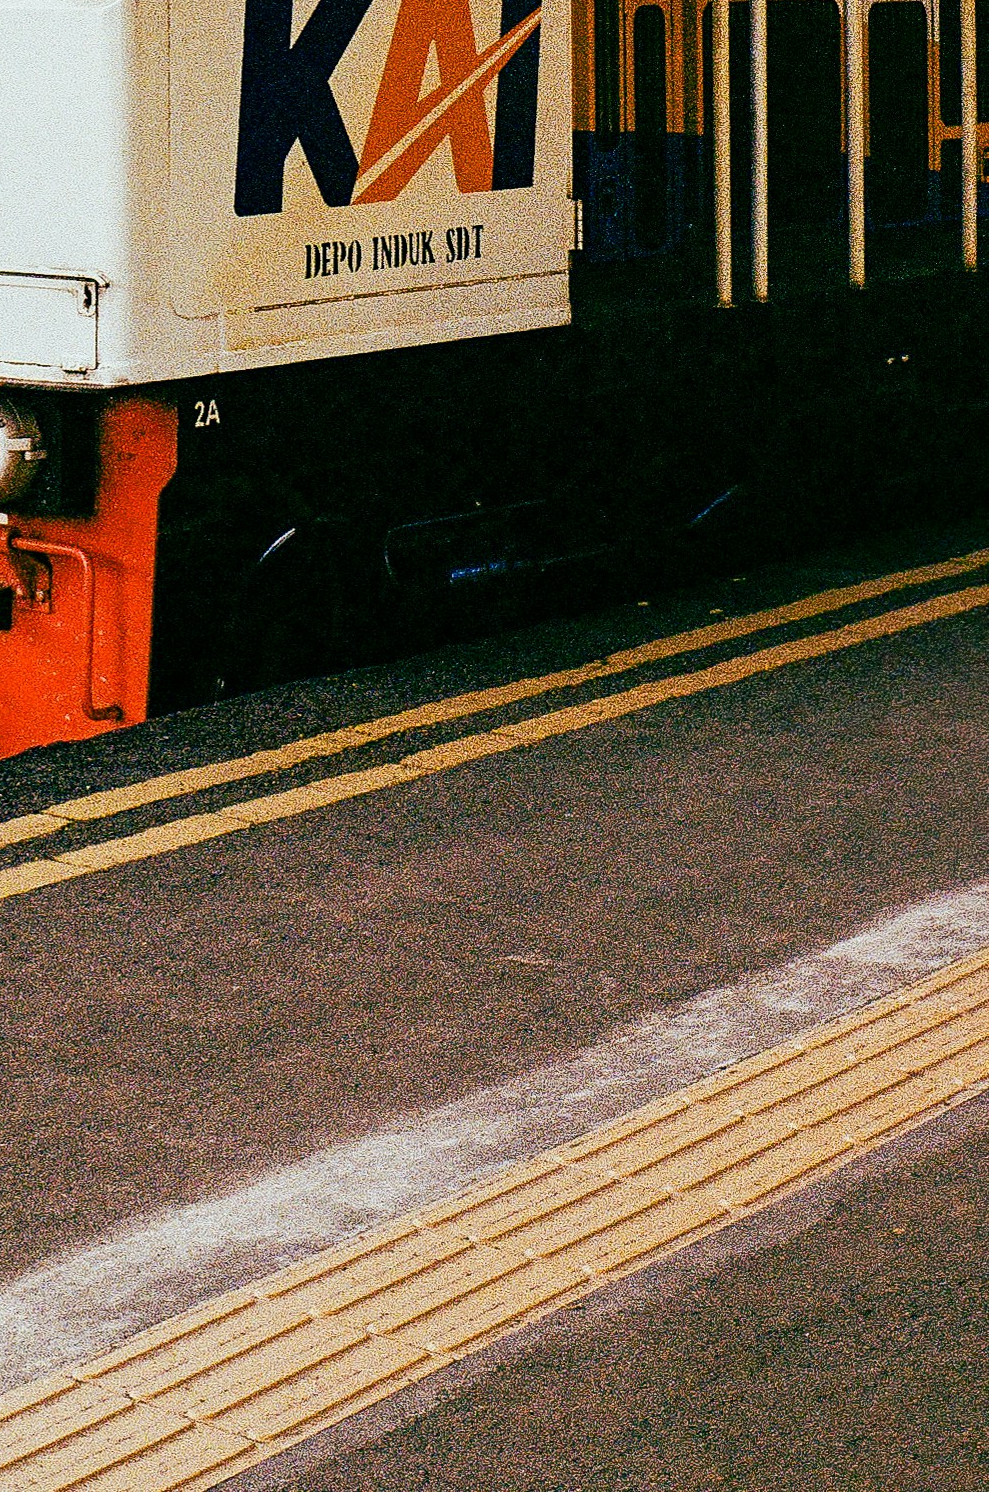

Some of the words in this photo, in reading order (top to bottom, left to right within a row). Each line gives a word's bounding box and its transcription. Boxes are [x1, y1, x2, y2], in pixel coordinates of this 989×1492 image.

[304, 239, 362, 279] DEPO
[372, 230, 436, 270] INDUK
[445, 224, 484, 263] SDT
[194, 400, 220, 427] 2A
